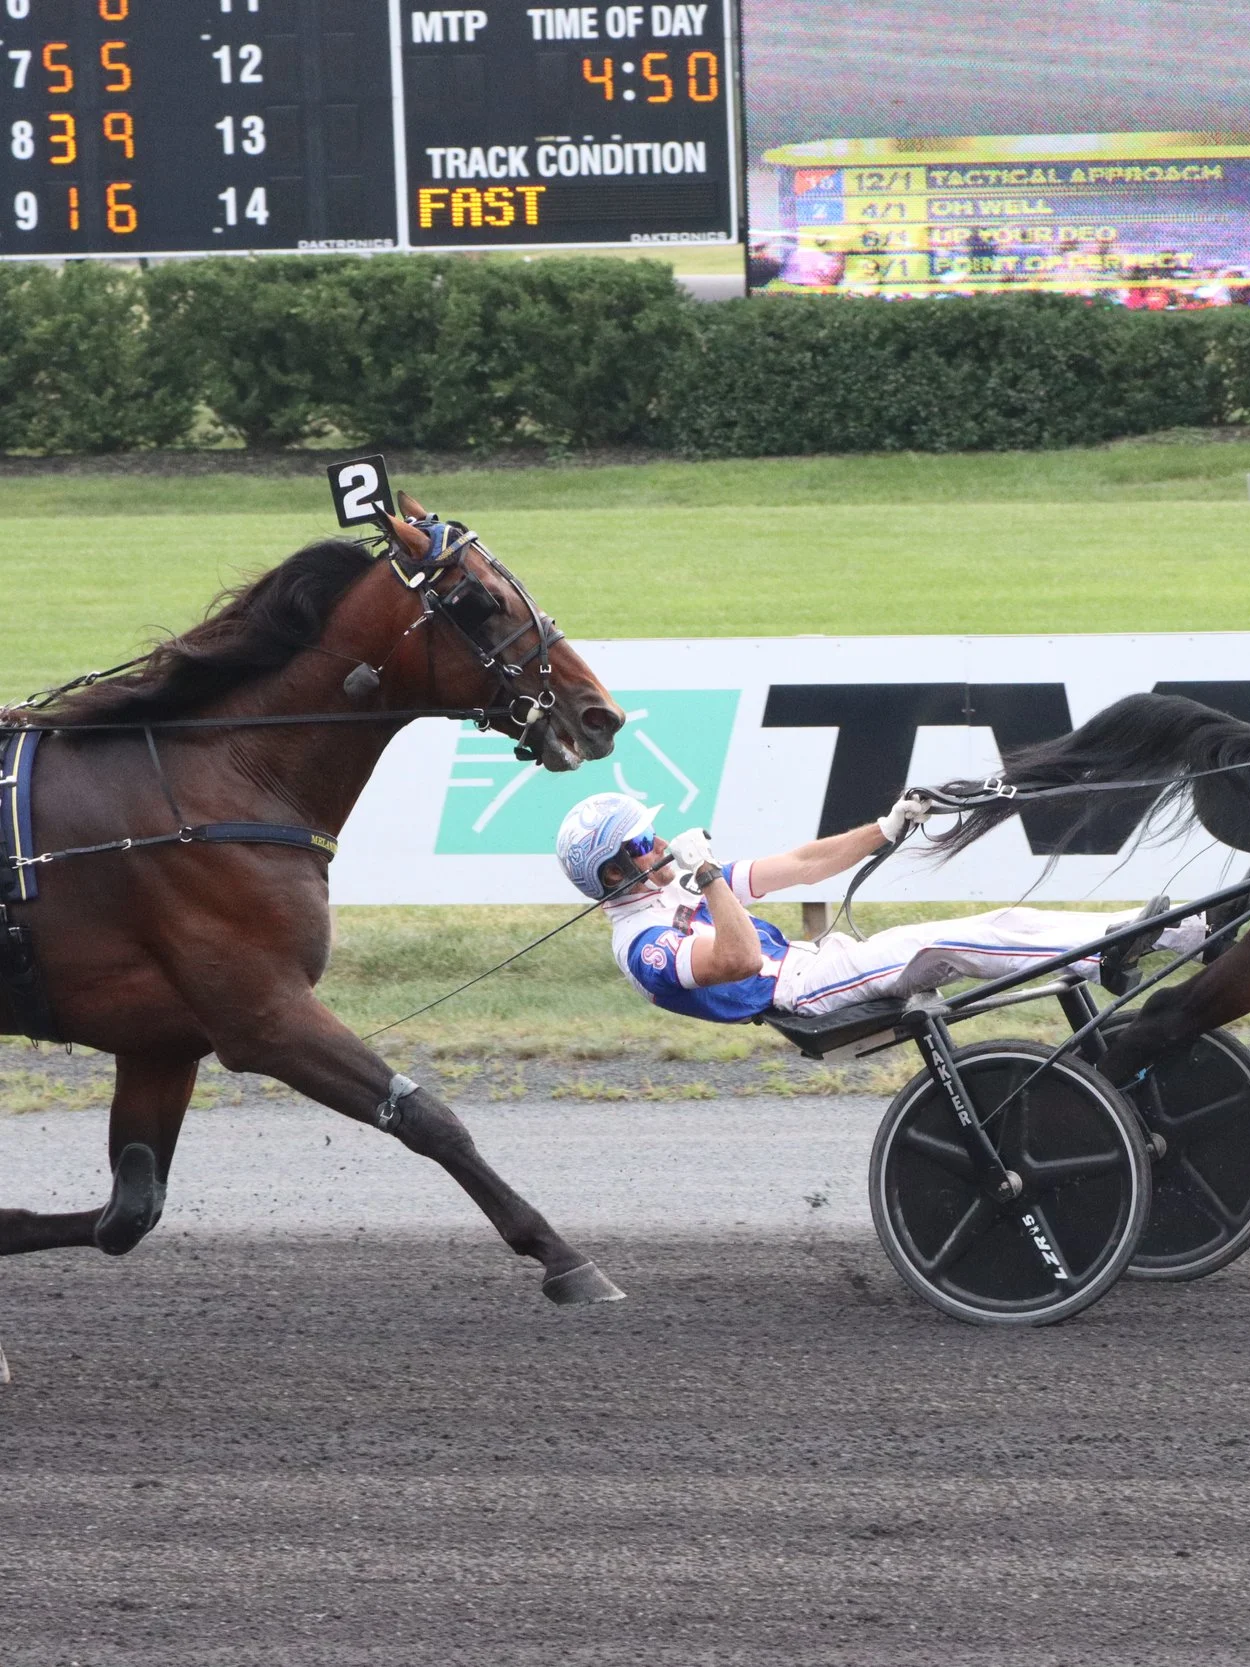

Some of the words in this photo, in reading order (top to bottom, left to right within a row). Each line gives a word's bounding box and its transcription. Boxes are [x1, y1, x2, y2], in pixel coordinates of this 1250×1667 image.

[412, 10, 488, 43] MTP
[527, 7, 598, 40] TIME
[605, 5, 644, 39] OF
[651, 4, 708, 37] DAY
[8, 51, 32, 88] 7
[212, 44, 264, 84] 12
[582, 51, 719, 103] 4:50
[11, 120, 35, 160] 8
[215, 115, 267, 155] 13
[426, 145, 530, 180] TRACK
[536, 141, 707, 178] CONDITION
[856, 171, 912, 192] 12/1
[930, 168, 1064, 186] TACTICAL
[1070, 165, 1225, 183] APPROACH
[13, 191, 39, 231] 9
[217, 186, 270, 226] 14
[418, 186, 547, 229] FAST
[980, 199, 1055, 214] WELL
[298, 238, 394, 250] DAKTRONICS
[629, 231, 728, 243] DAKTRONICS
[338, 463, 386, 519] 2
[923, 1034, 972, 1127] TAKTER
